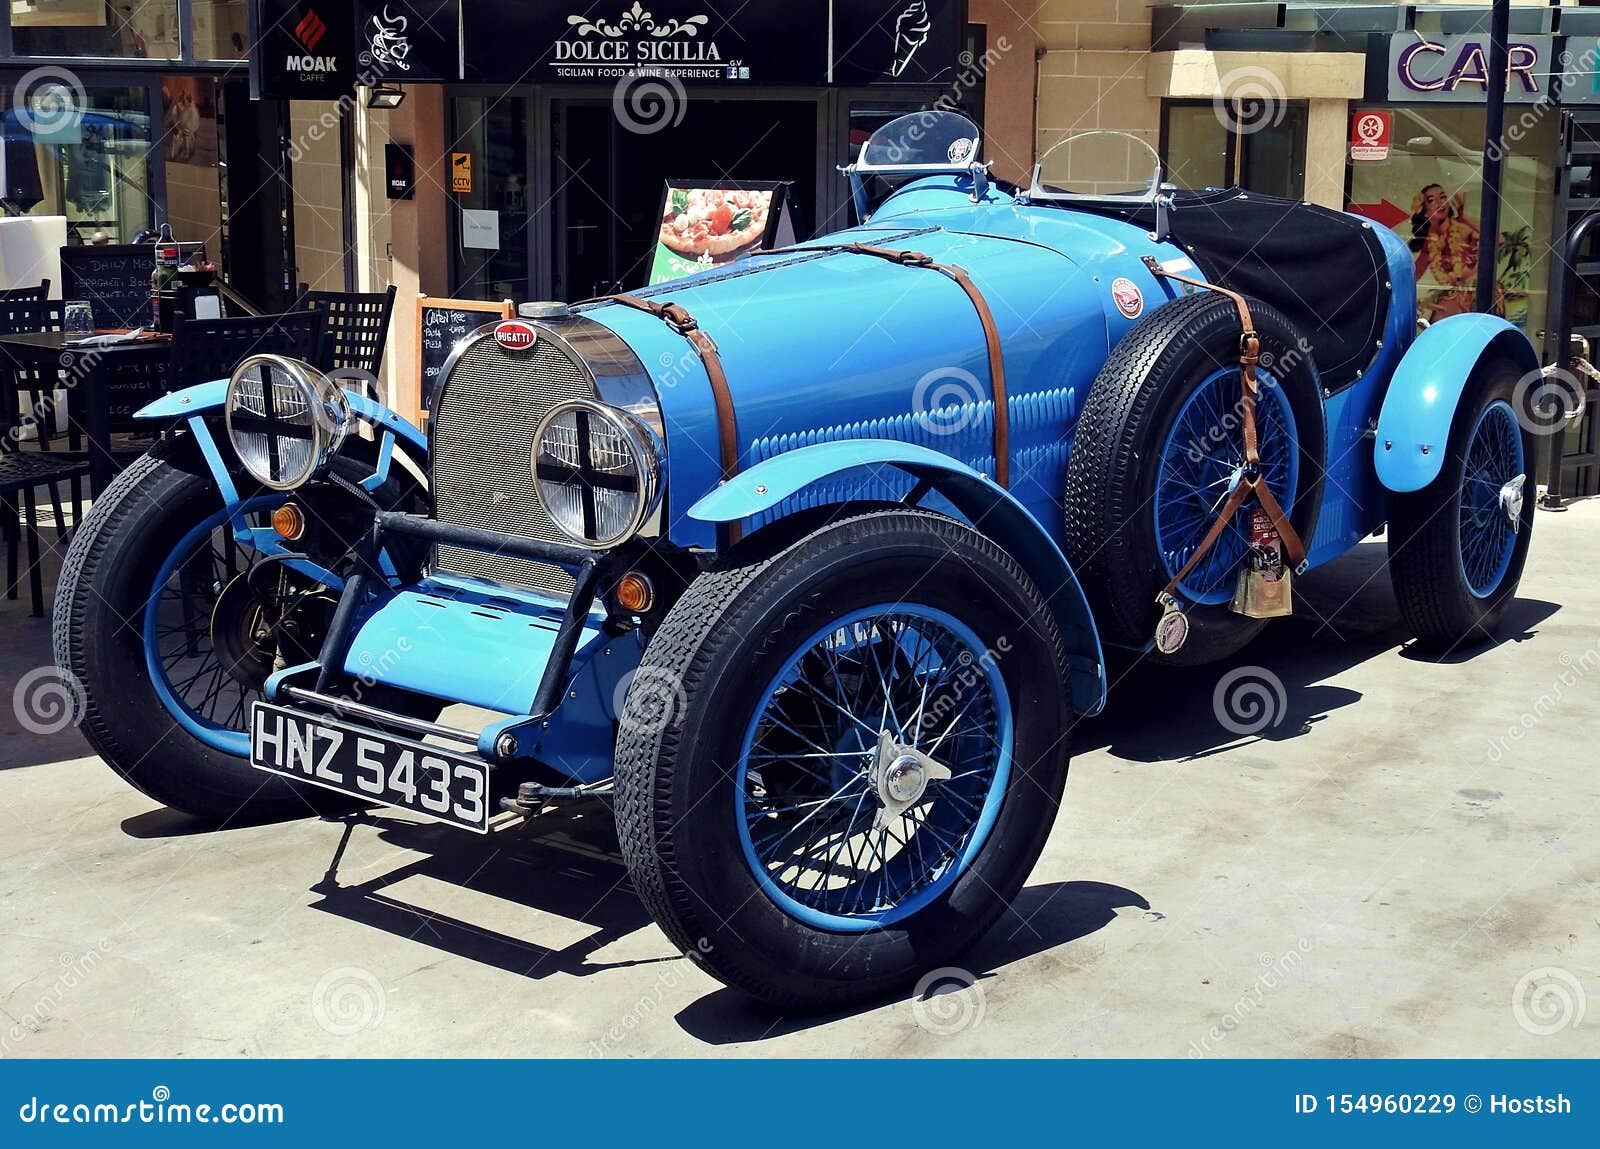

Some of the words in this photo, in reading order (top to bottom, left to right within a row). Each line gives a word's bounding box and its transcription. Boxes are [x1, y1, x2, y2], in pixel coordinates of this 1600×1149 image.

[555, 41, 629, 60] DOLCE
[637, 41, 721, 61] SICILIA
[286, 55, 337, 72] MOAK
[1397, 41, 1539, 92] CAR
[557, 68, 594, 77] SICILIAN
[598, 68, 626, 77] FOOD
[628, 69, 635, 77] &
[637, 68, 661, 77] WINE
[664, 68, 721, 78] EXPERIENCE
[453, 178, 470, 186] CCTV
[132, 256, 155, 270] MEN
[497, 331, 530, 343] BUGATTI
[255, 710, 344, 784] HNZ
[356, 737, 484, 823] 5433
